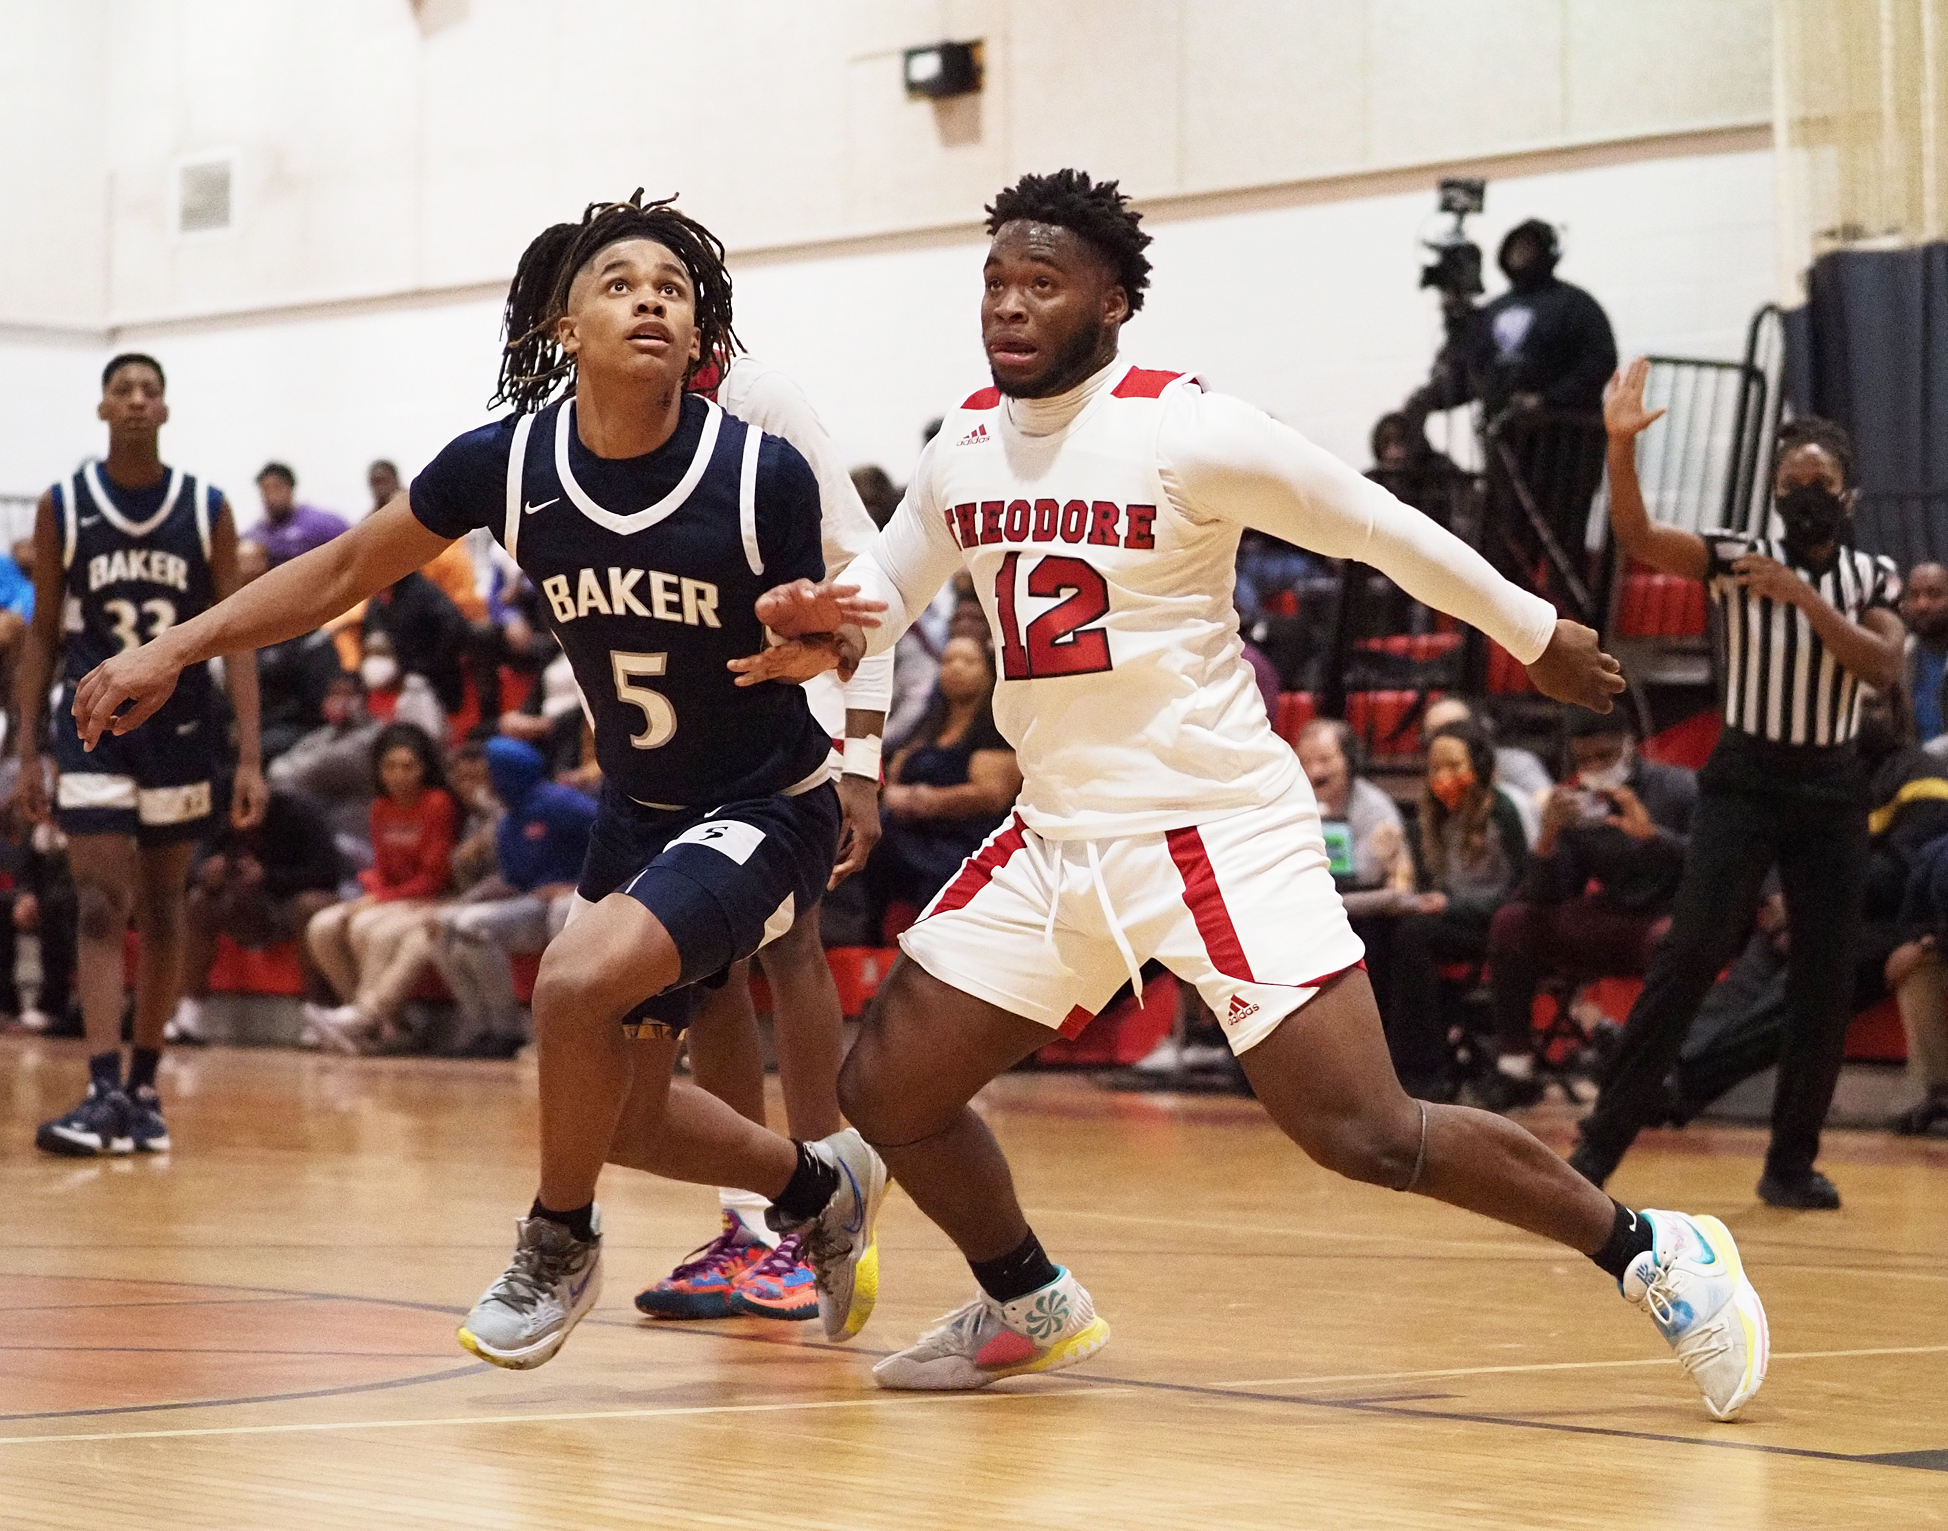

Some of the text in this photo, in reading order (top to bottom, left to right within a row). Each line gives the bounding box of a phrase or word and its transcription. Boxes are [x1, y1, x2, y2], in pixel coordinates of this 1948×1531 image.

[89, 549, 188, 592] BAKER
[542, 566, 722, 629] BAKER
[994, 551, 1113, 681] 12
[610, 650, 678, 750] 5
[1228, 1003, 1260, 1026] adidas
